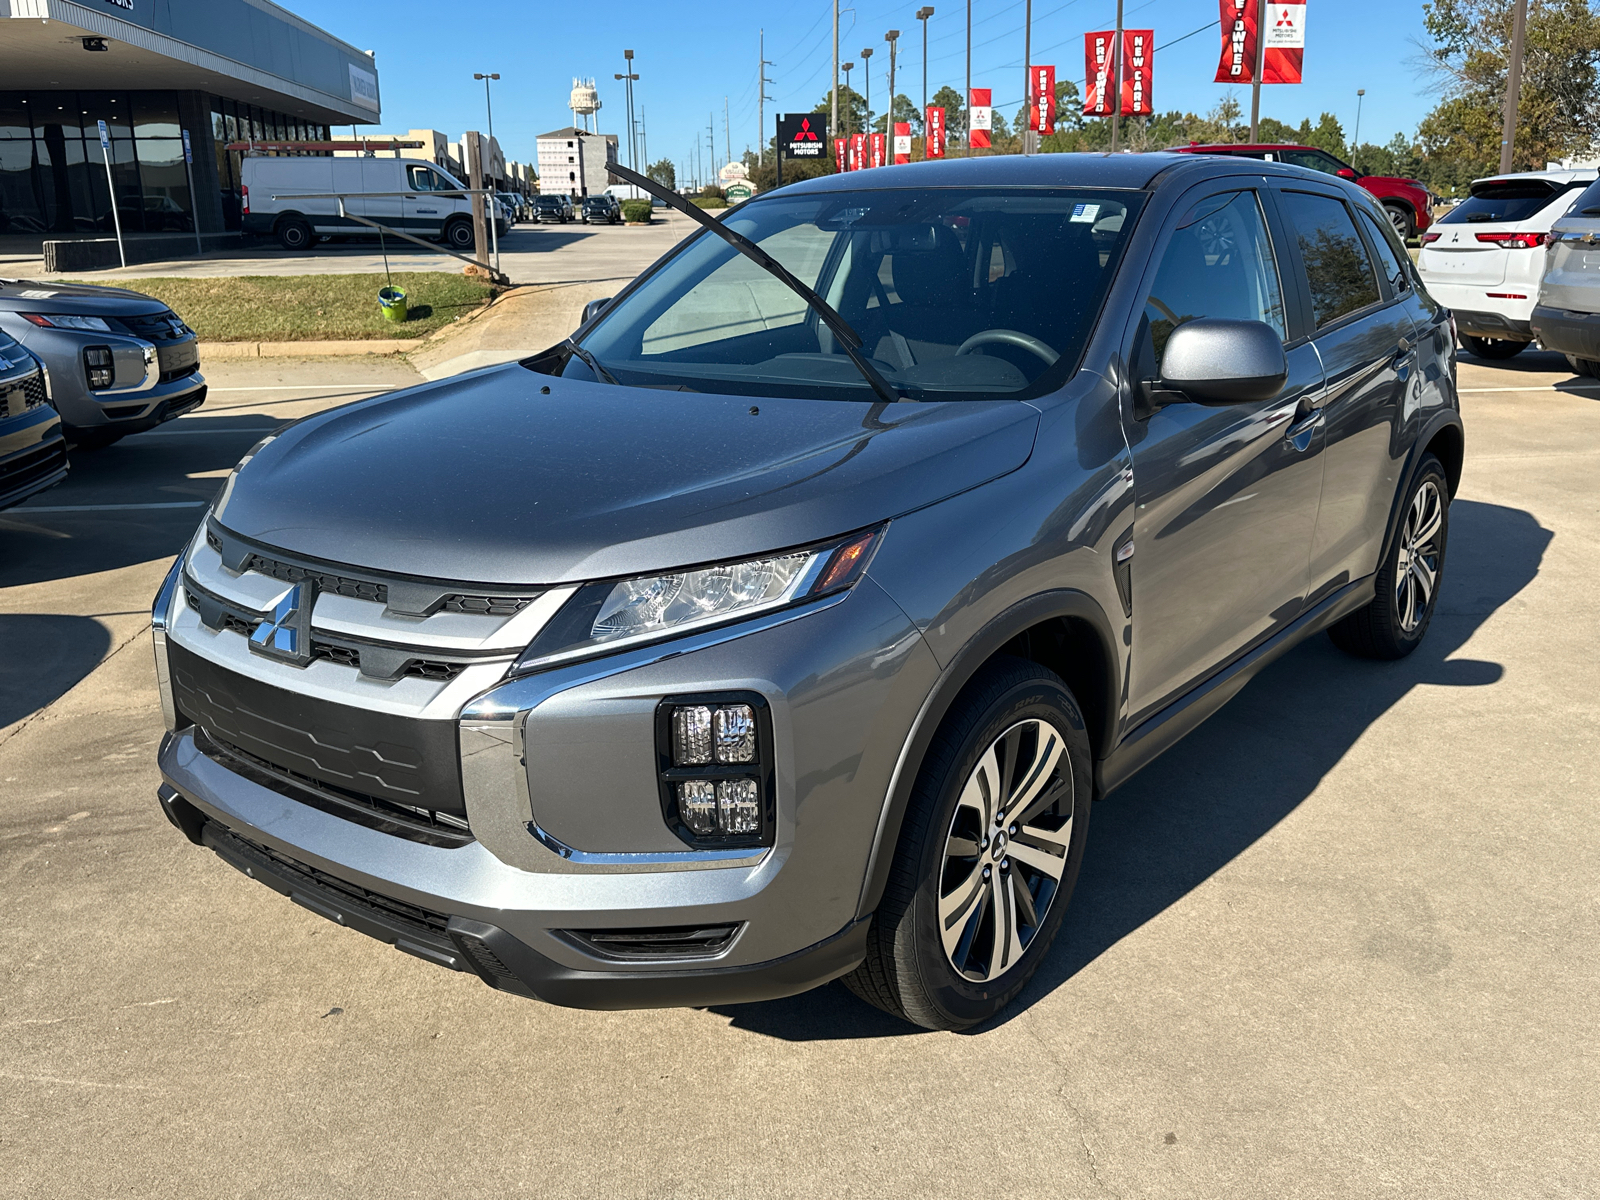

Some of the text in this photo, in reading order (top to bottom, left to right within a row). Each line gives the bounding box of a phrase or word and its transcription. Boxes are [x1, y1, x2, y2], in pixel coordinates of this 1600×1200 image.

[1038, 70, 1049, 131] PRE-OWNED
[1095, 37, 1107, 112] PRE-OWNED
[1132, 36, 1144, 112] NEW CARS
[932, 110, 940, 129] NEW
